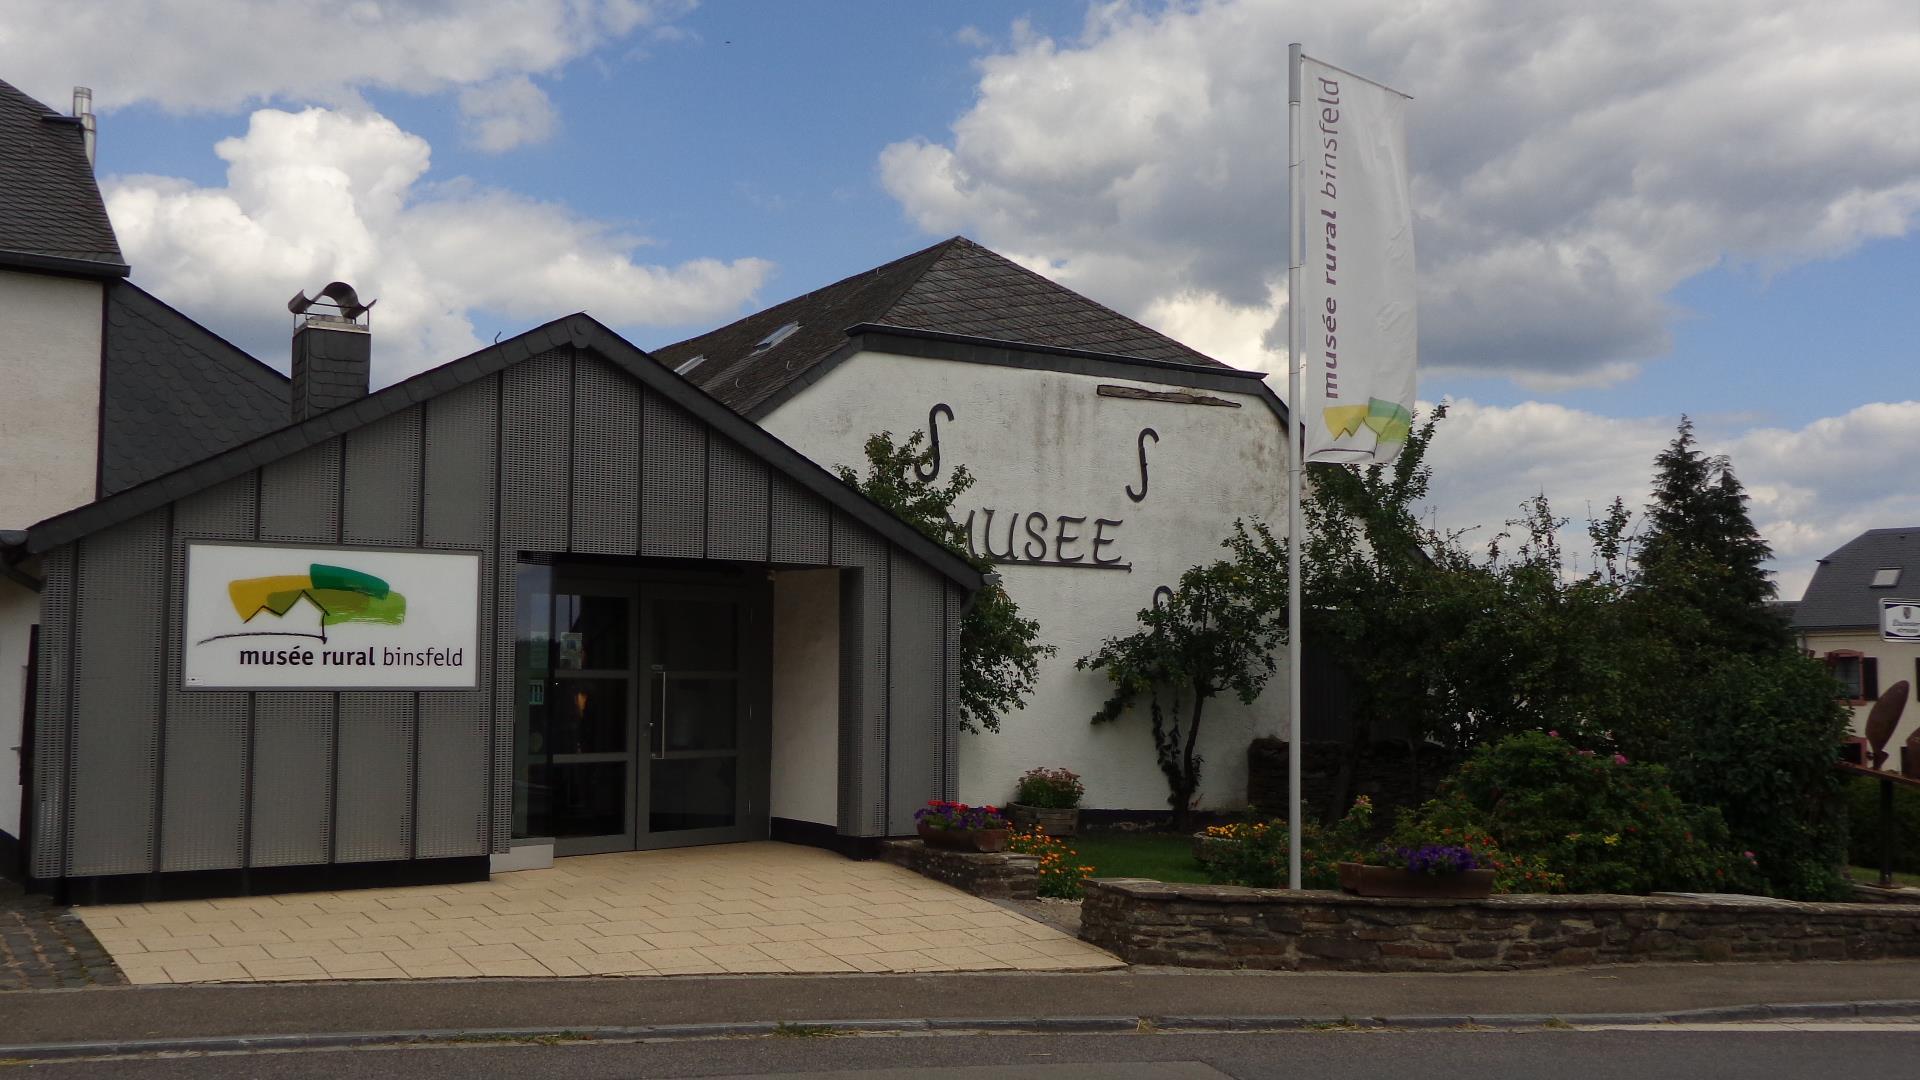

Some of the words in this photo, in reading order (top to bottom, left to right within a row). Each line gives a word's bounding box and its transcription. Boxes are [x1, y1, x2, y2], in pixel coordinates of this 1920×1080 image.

[1318, 77, 1341, 200] binsfeld
[1320, 208, 1337, 286] rural
[1321, 297, 1339, 399] musée
[239, 645, 314, 666] musée
[322, 646, 376, 666] rural
[382, 647, 464, 667] binsfeld
